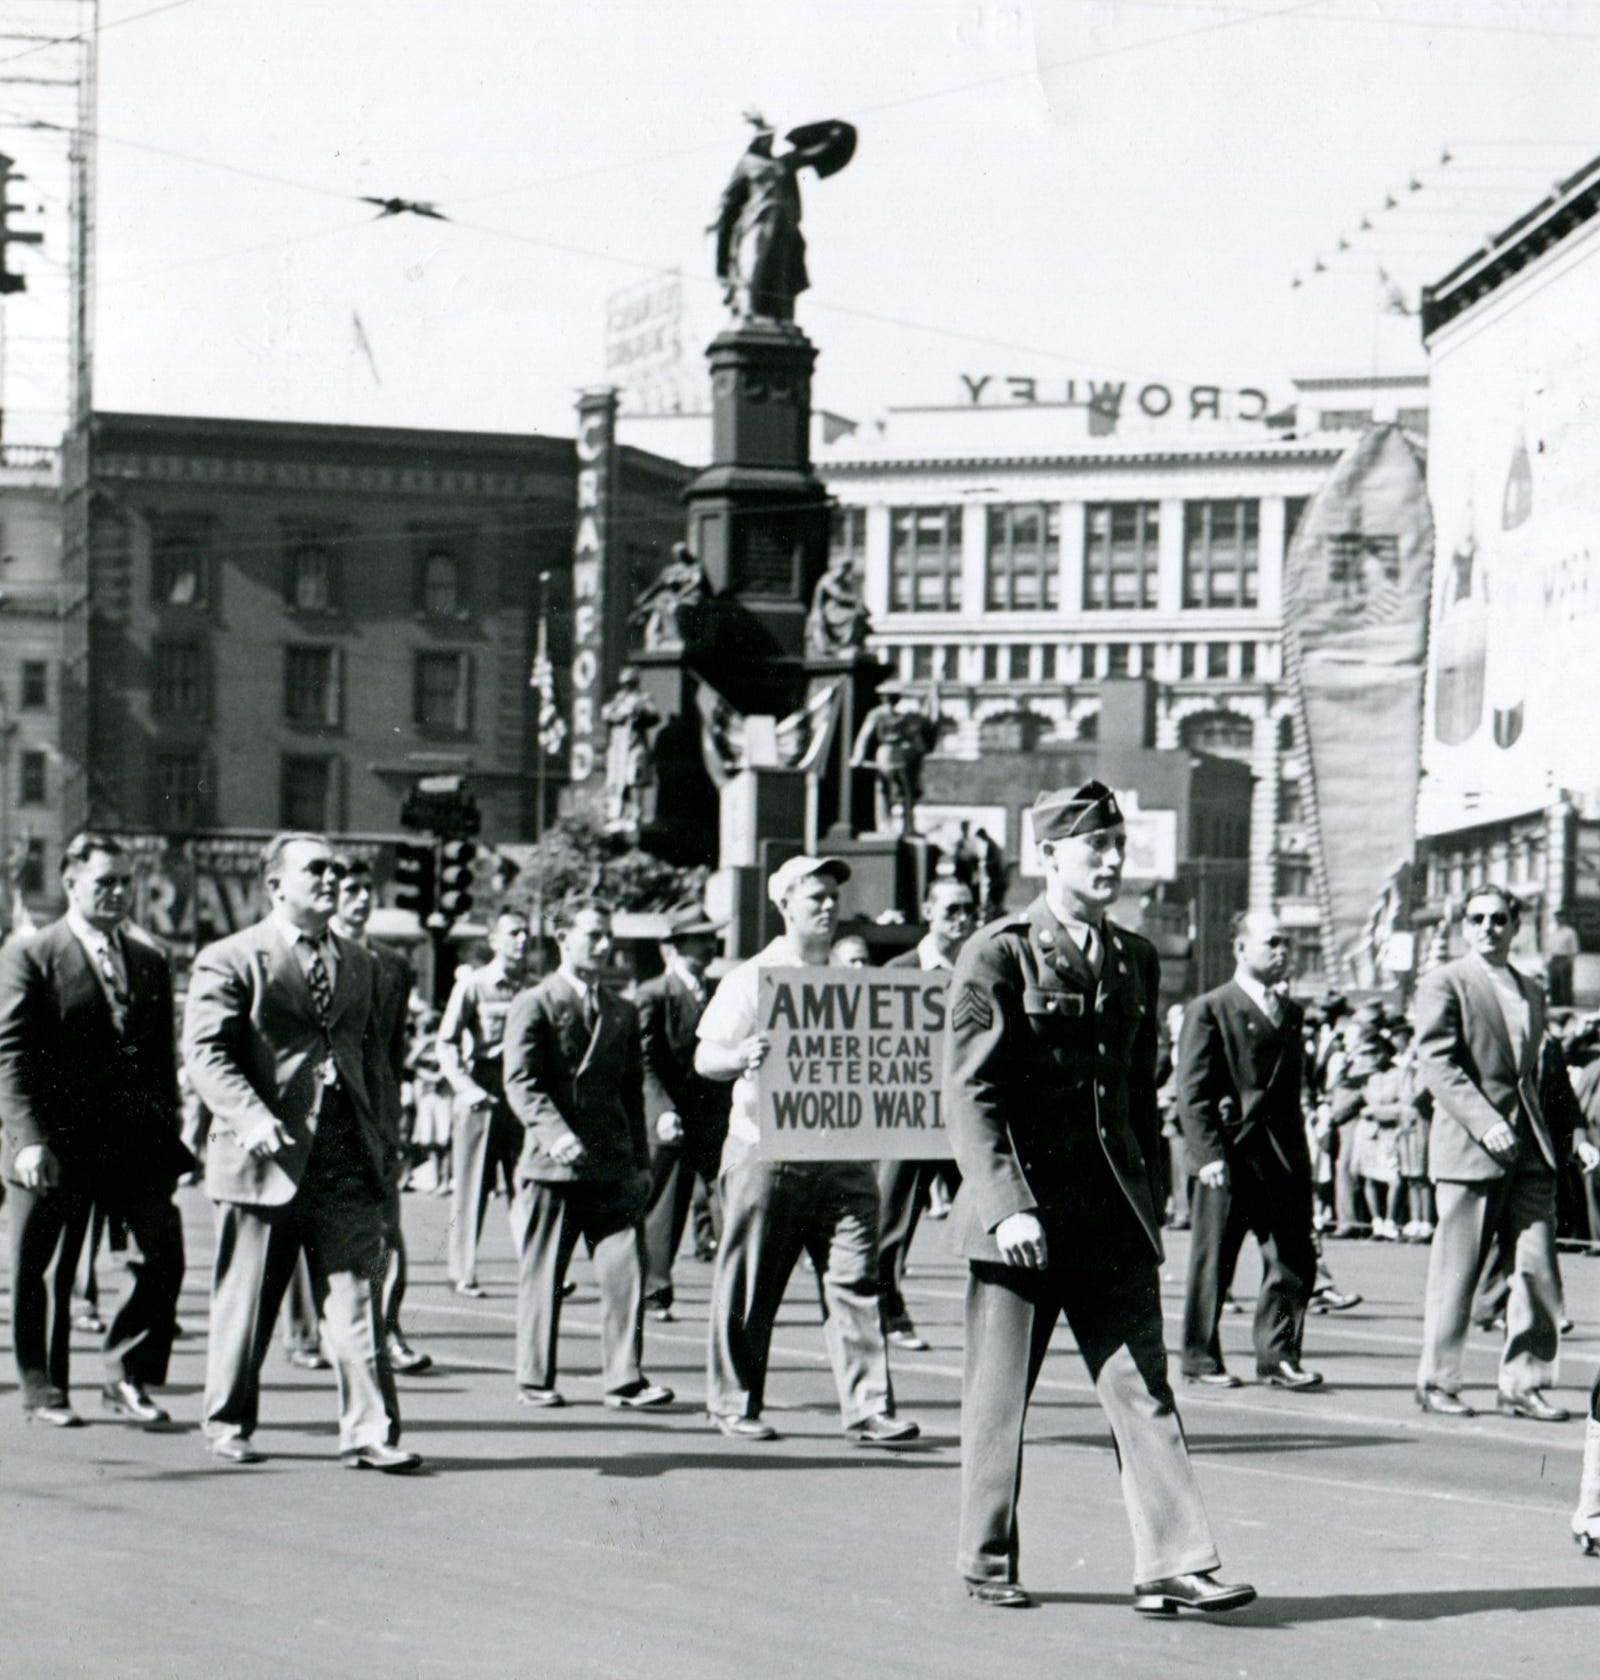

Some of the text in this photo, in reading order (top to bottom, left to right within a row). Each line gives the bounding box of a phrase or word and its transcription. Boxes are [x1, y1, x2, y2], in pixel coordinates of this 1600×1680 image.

[767, 982, 946, 1033] AMVETS
[786, 1035, 930, 1059] AMERICAN
[788, 1060, 933, 1086] VETERANS
[772, 1090, 862, 1130] WORLD
[873, 1090, 926, 1130] WAR
